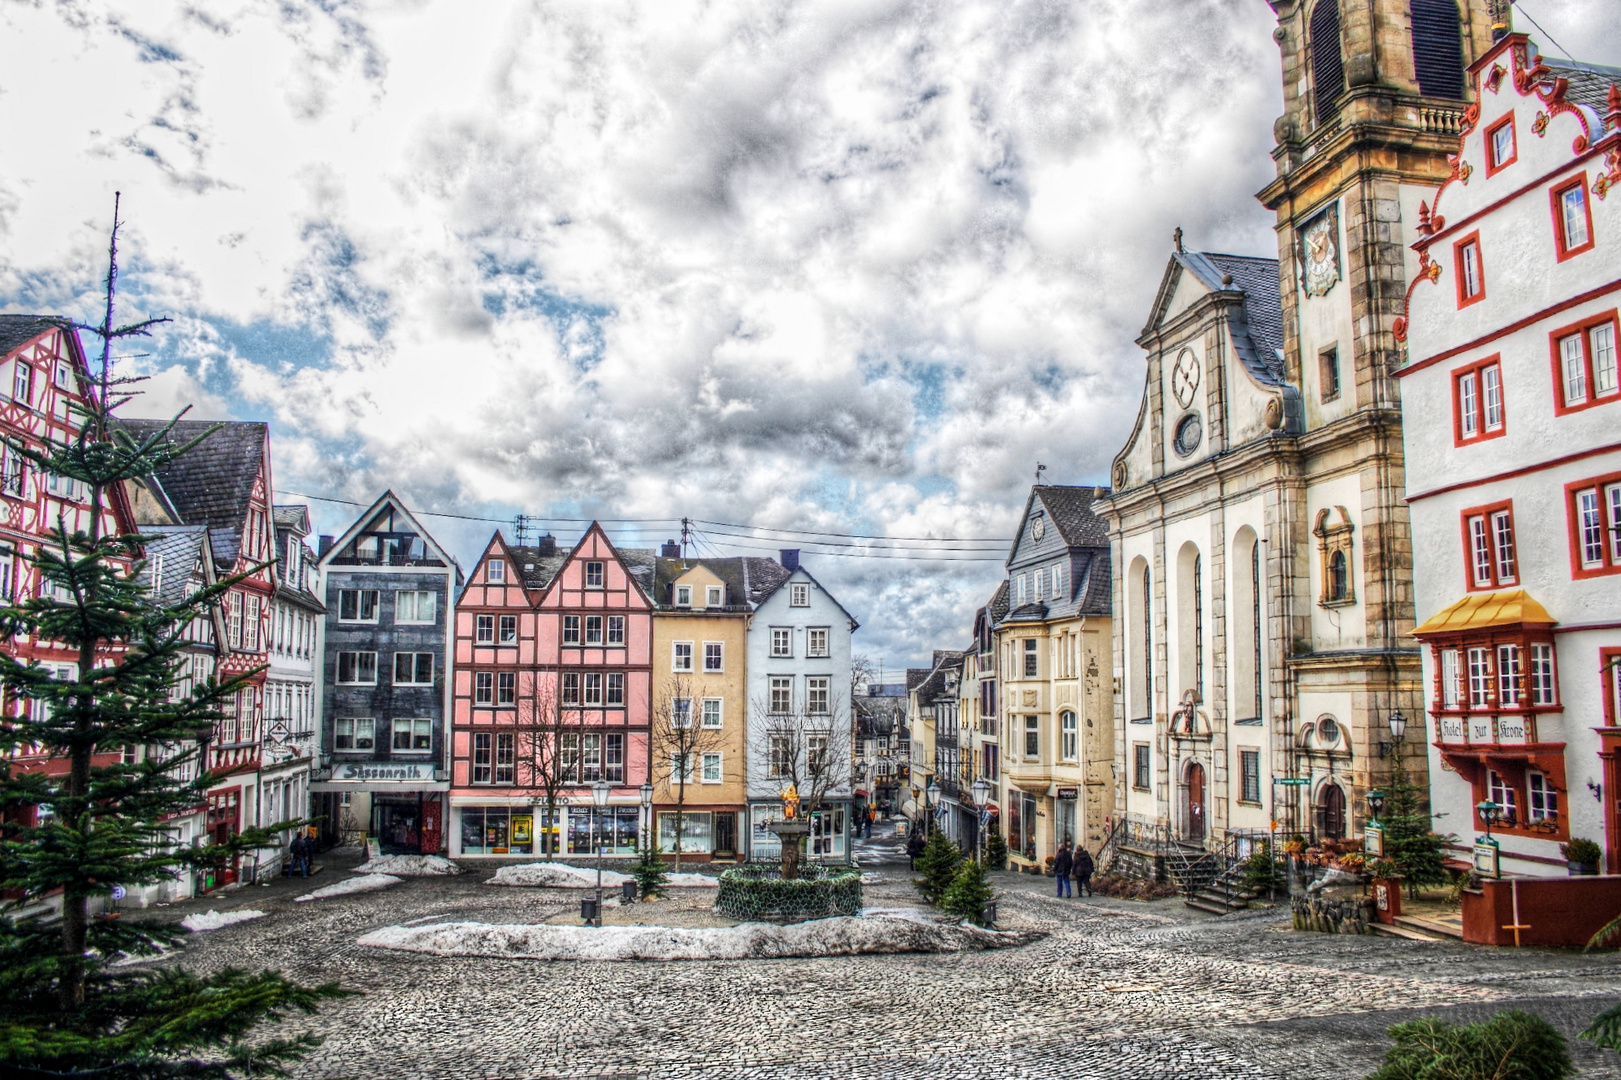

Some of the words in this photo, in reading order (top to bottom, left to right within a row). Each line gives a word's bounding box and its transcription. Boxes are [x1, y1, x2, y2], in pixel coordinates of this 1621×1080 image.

[1443, 721, 1462, 737] Hotel
[1475, 725, 1487, 739] zur
[1500, 720, 1524, 738] Krone
